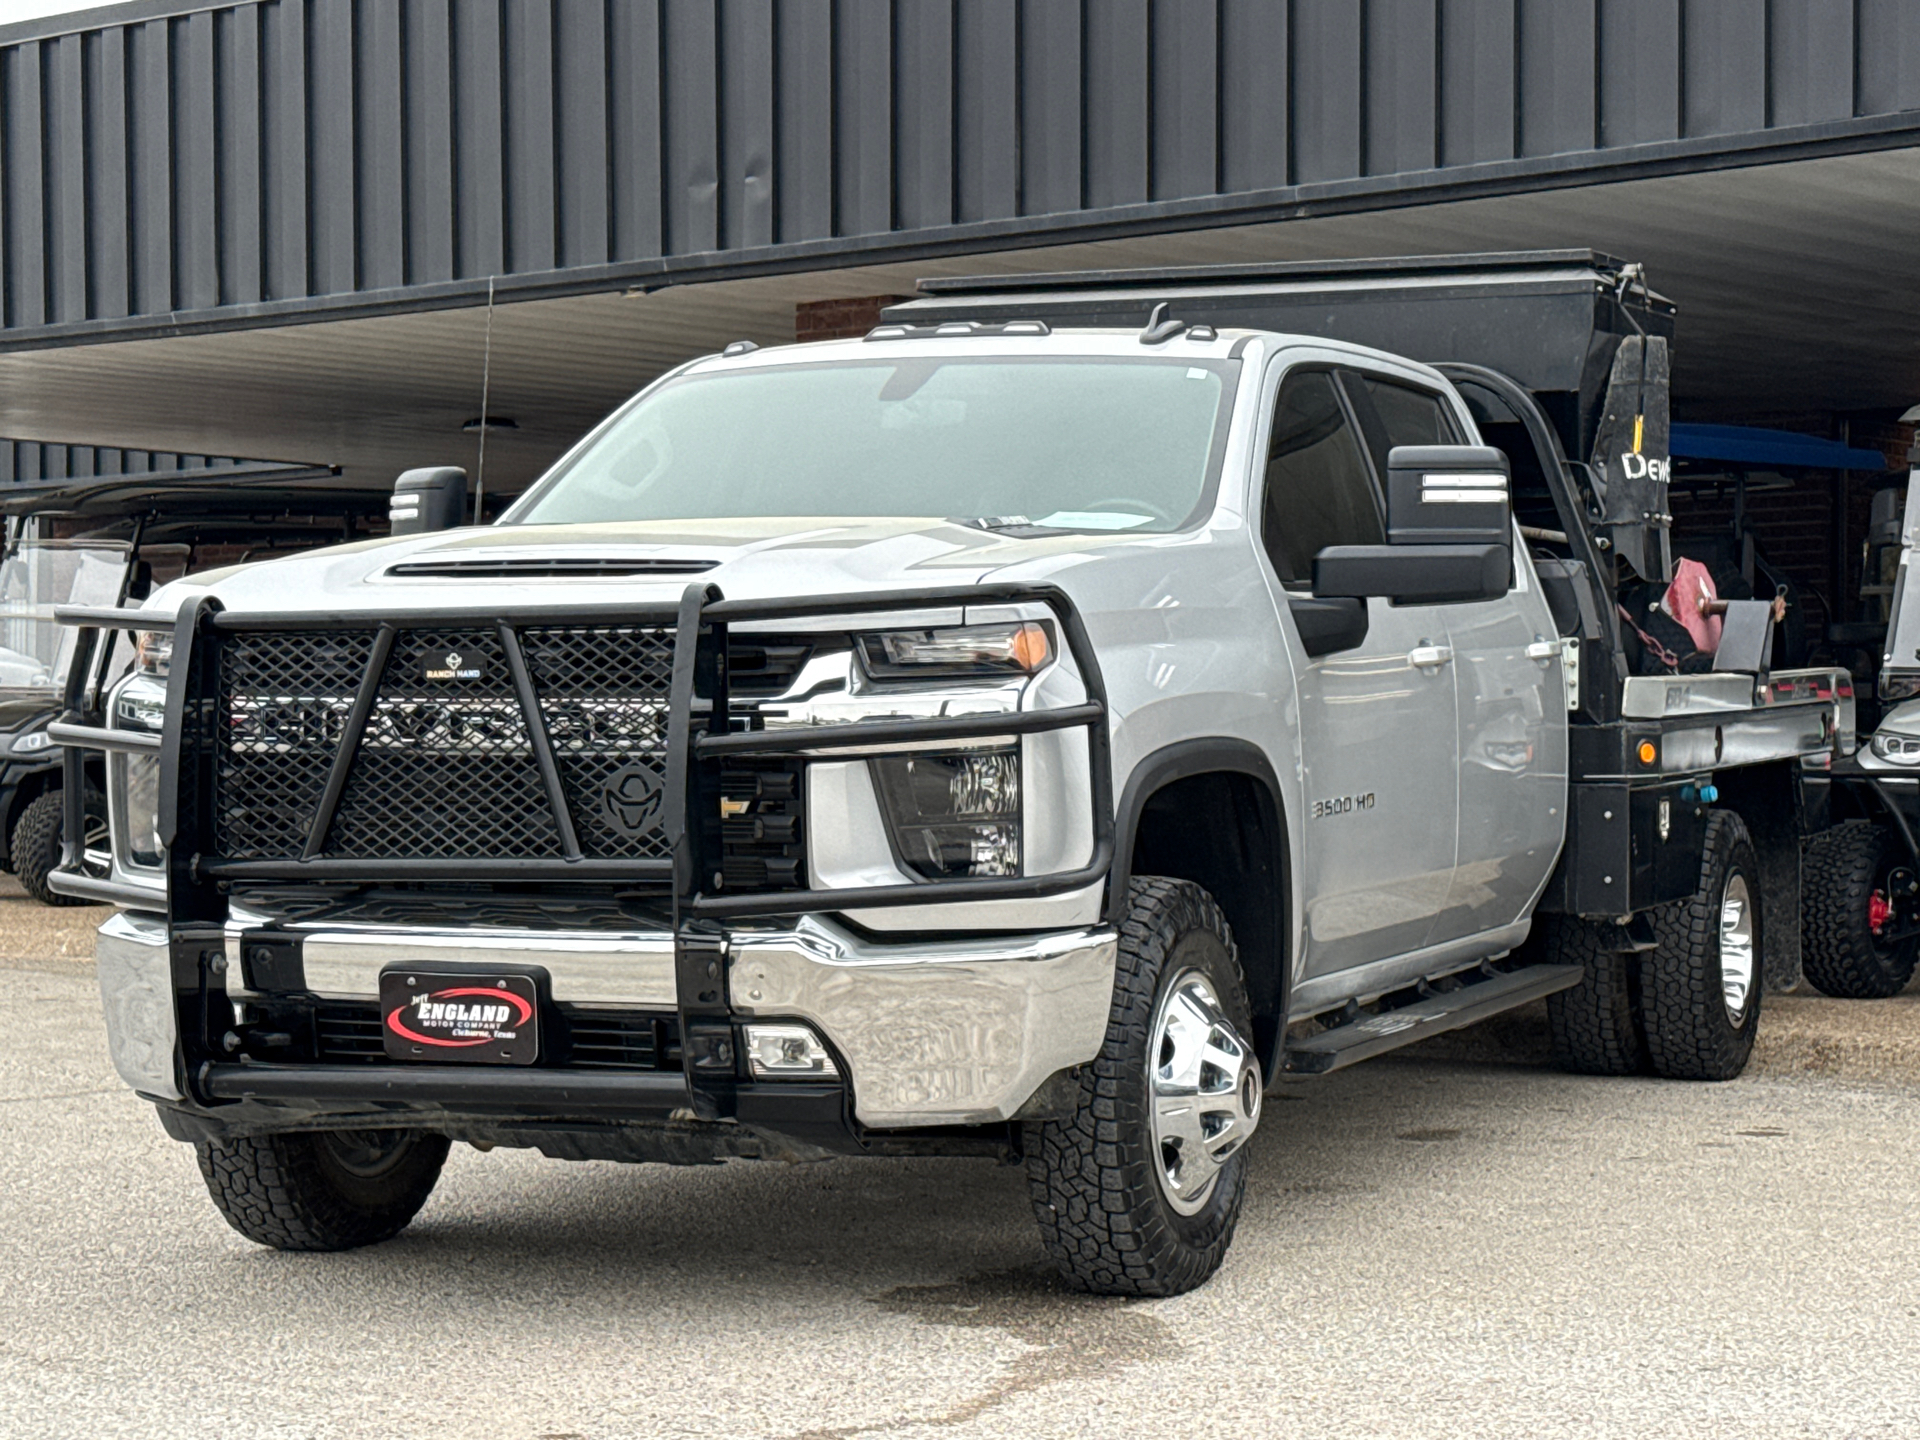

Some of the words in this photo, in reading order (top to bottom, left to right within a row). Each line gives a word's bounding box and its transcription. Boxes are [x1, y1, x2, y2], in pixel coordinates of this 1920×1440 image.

[426, 669, 456, 678] RANCH
[457, 669, 480, 678] HAND
[1311, 797, 1352, 819] 3500
[1354, 792, 1375, 811] HD
[411, 993, 429, 1006] Jeff
[417, 1003, 510, 1022] ENGLAND
[457, 1021, 501, 1029] COMPANY
[494, 1030, 516, 1039] Texas
